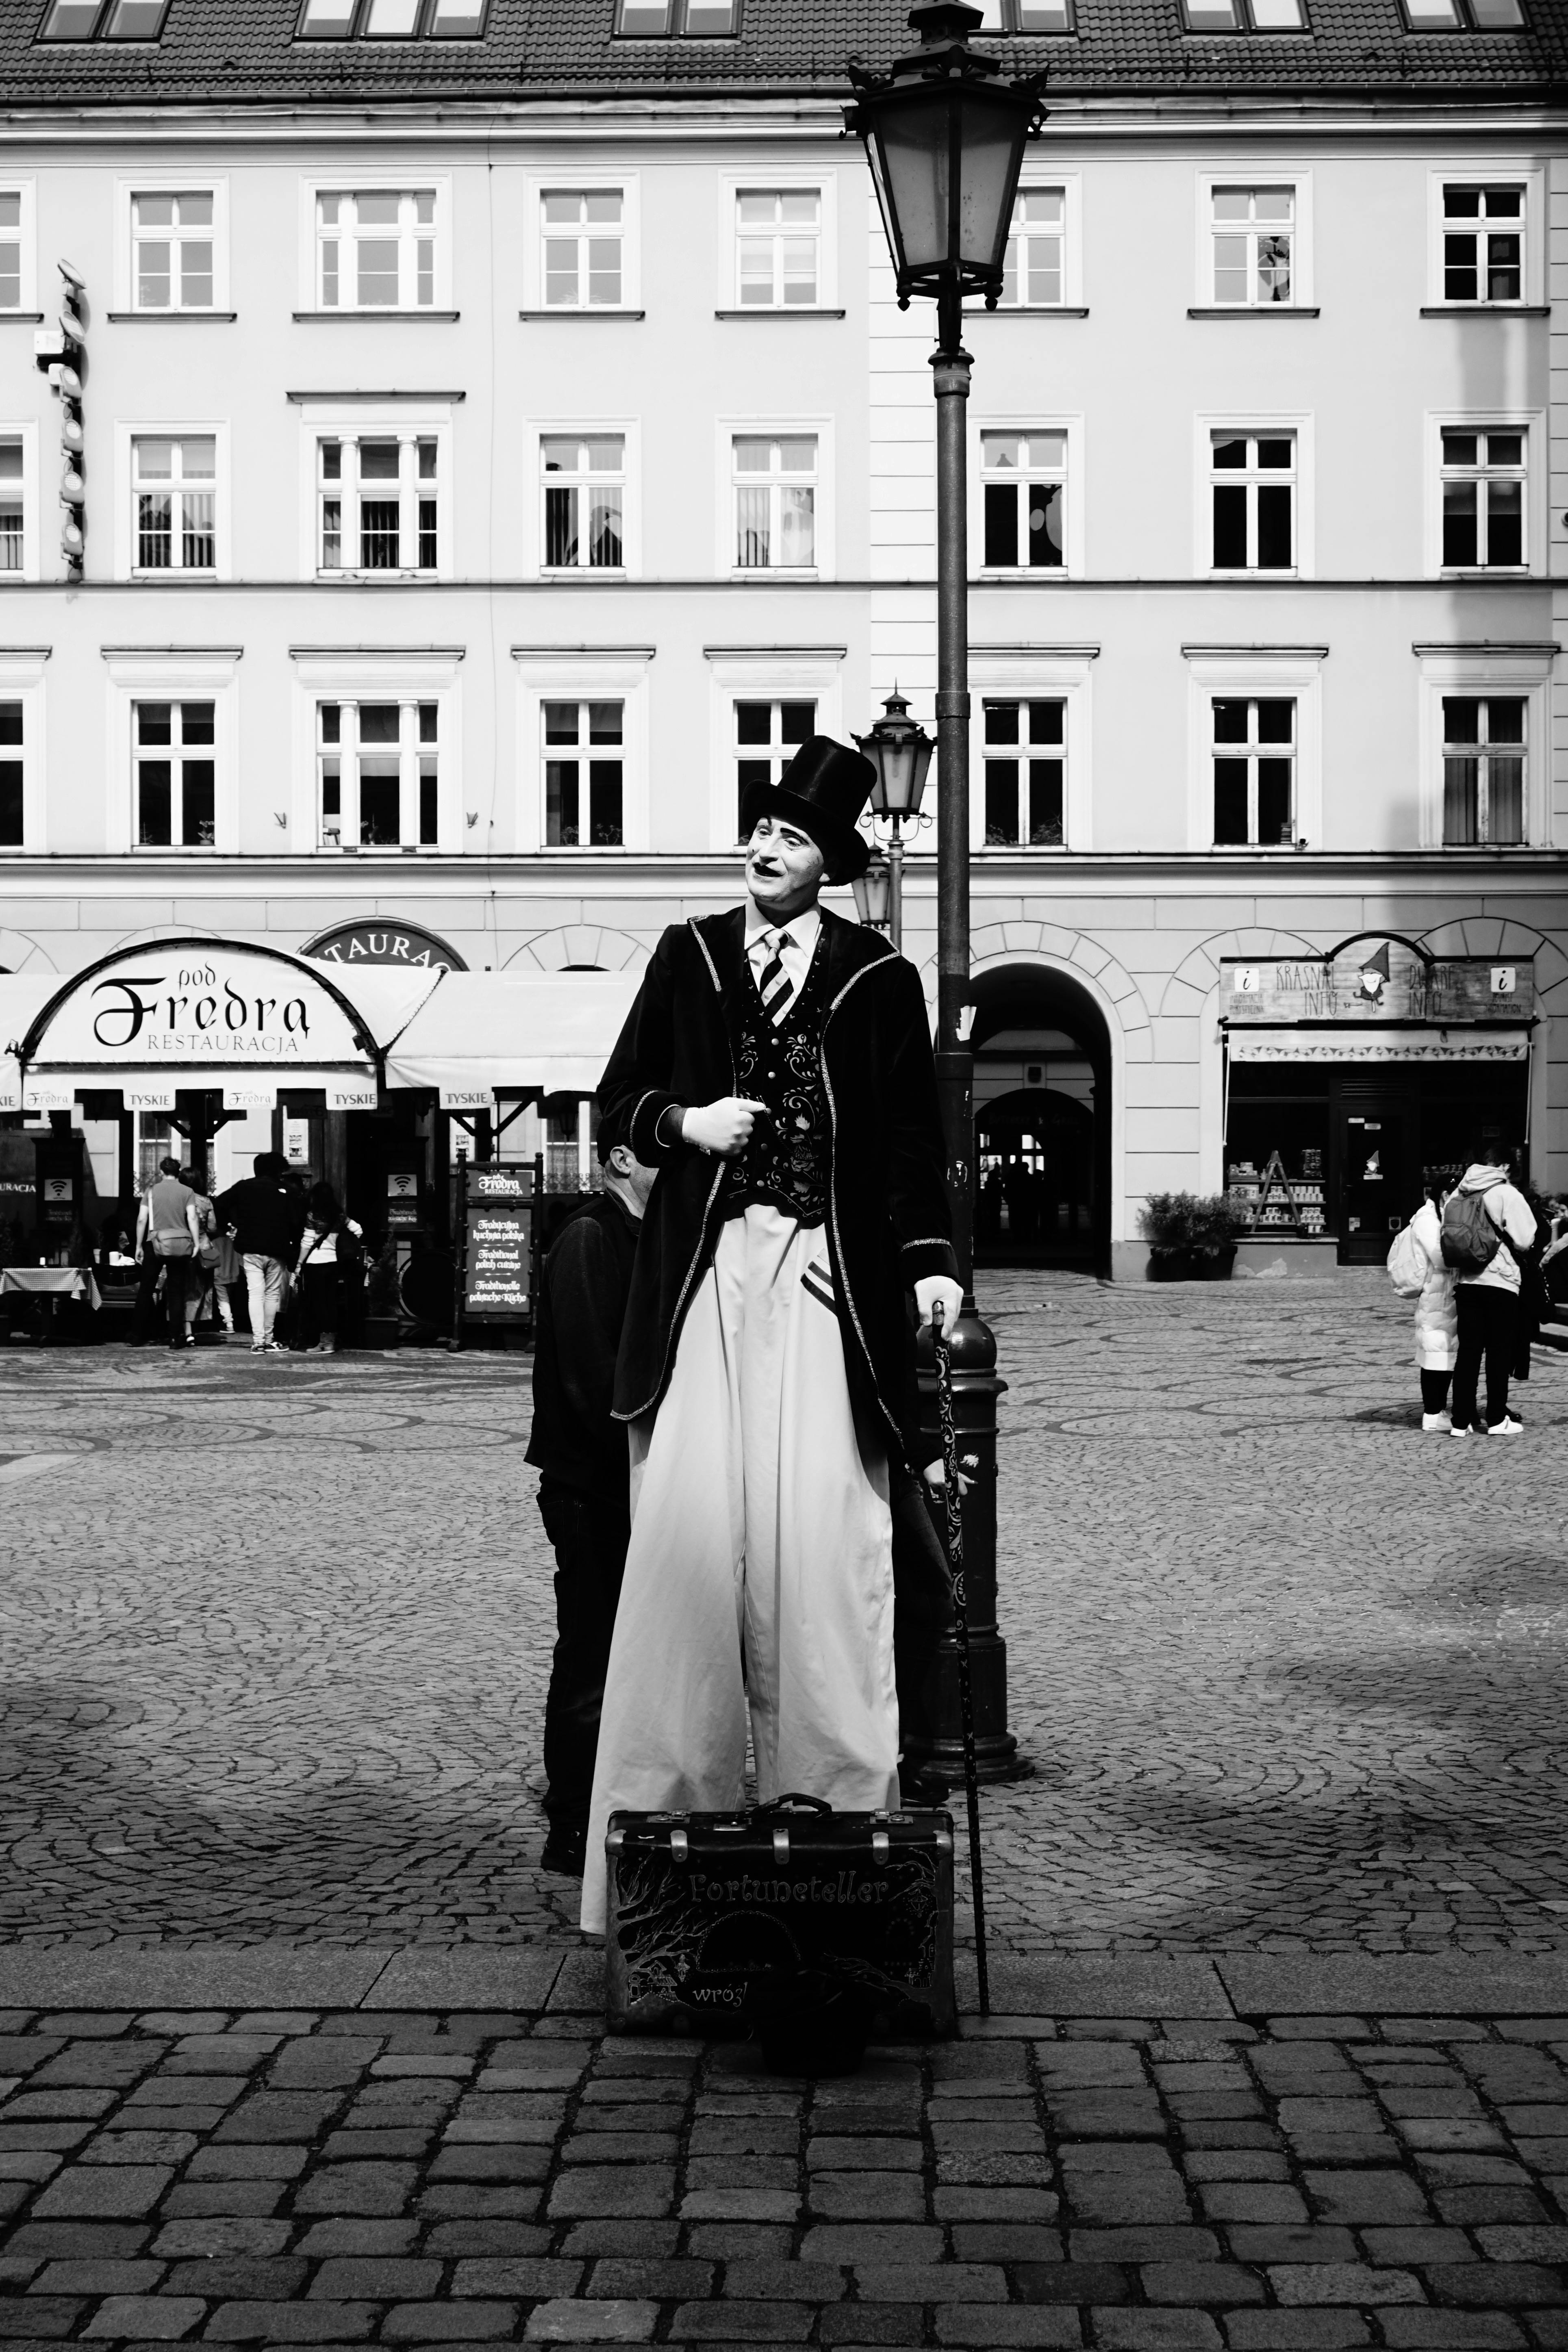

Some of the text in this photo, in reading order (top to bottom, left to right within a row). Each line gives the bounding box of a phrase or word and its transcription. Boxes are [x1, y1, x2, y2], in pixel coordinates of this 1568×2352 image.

[178, 961, 215, 991] pod
[1277, 965, 1339, 990] KRASNAL
[1305, 991, 1338, 1016] INFO
[1409, 991, 1442, 1016] INFO
[147, 1035, 299, 1055] RESTAURACJA
[129, 1095, 170, 1105] TYSKIE
[333, 1094, 376, 1104] TYSKIE
[445, 1093, 488, 1104] TYSKIE
[502, 1230, 525, 1242] polska
[478, 1249, 519, 1260] Traditional
[476, 1259, 521, 1271] polish cuisine
[688, 1870, 889, 1904] Fortuneteller
